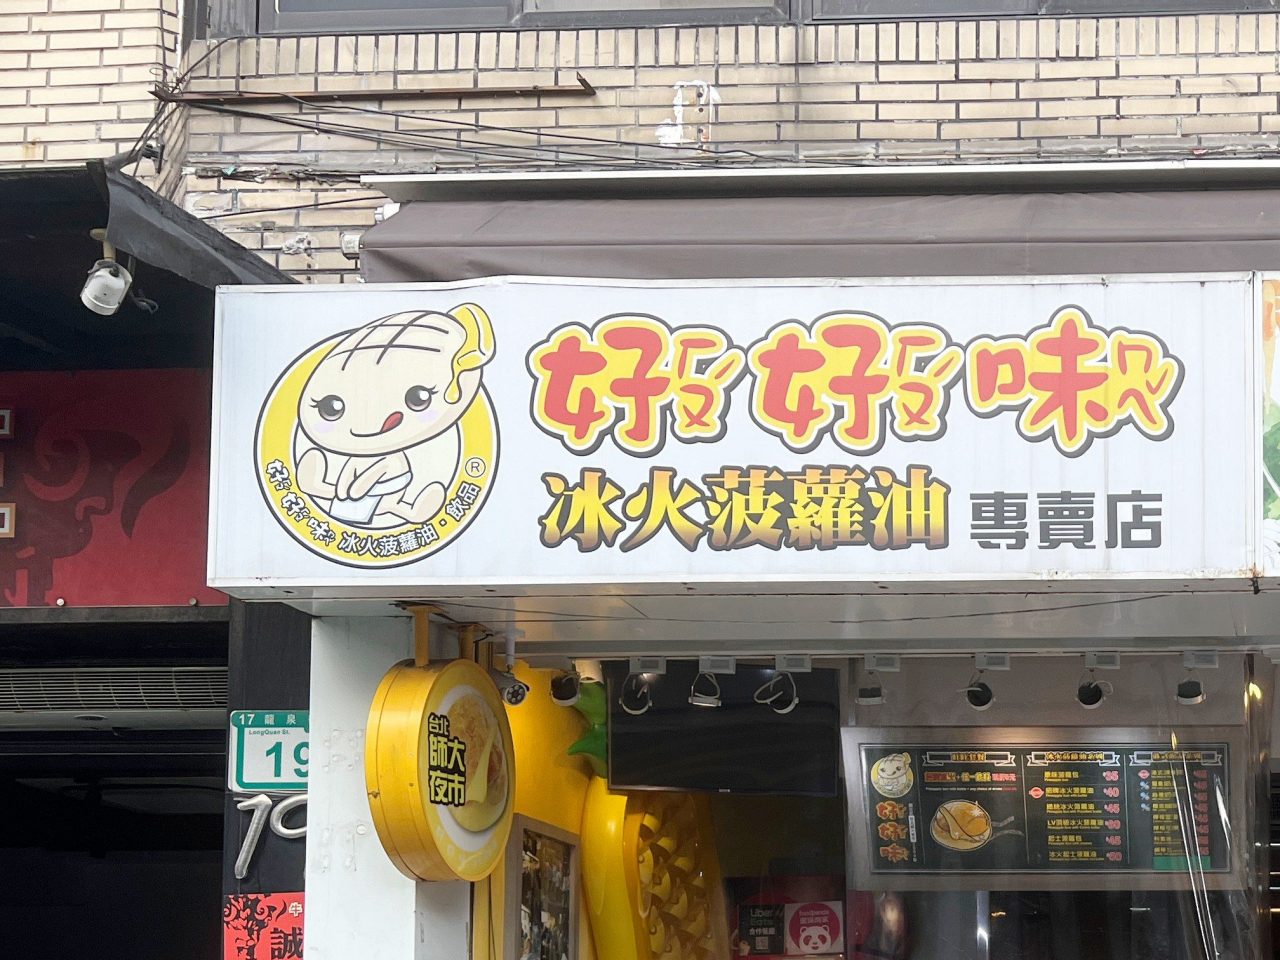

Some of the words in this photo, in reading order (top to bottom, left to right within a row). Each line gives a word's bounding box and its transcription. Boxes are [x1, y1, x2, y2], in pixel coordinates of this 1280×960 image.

[540, 463, 951, 553] 冰火菠蘿油
[970, 490, 1163, 549] 專賣店
[239, 714, 255, 725] 17
[429, 714, 449, 736] 台北
[266, 741, 309, 778] 19
[429, 735, 466, 773] 師大
[429, 769, 466, 806] 夜市
[288, 902, 303, 917] 牛
[270, 928, 303, 960] 誠
